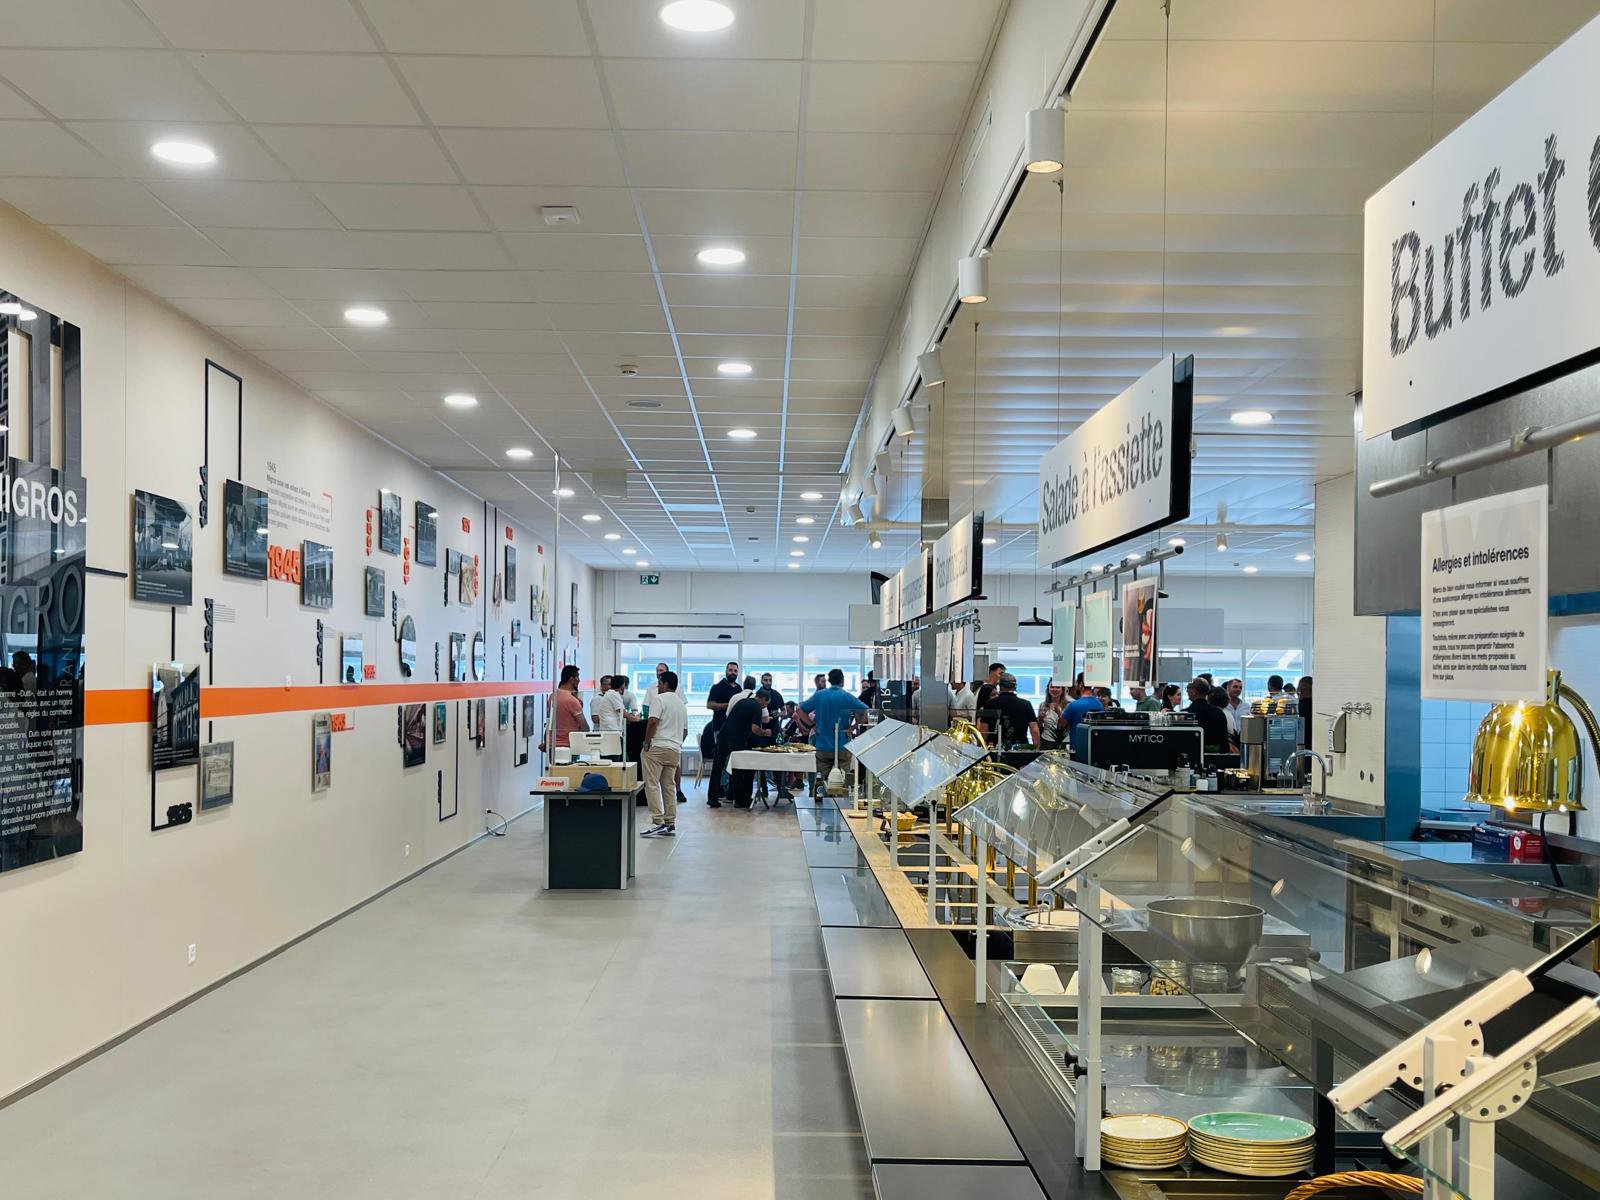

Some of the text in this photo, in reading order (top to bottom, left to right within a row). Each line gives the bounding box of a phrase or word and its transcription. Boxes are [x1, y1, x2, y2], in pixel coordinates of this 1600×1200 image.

[1390, 132, 1565, 358] Buffet
[1042, 411, 1164, 535] Salade à l'assiette
[267, 544, 302, 585] 1945
[1432, 546, 1529, 574] Allergies et intolérences
[1129, 734, 1164, 744] MYTICO
